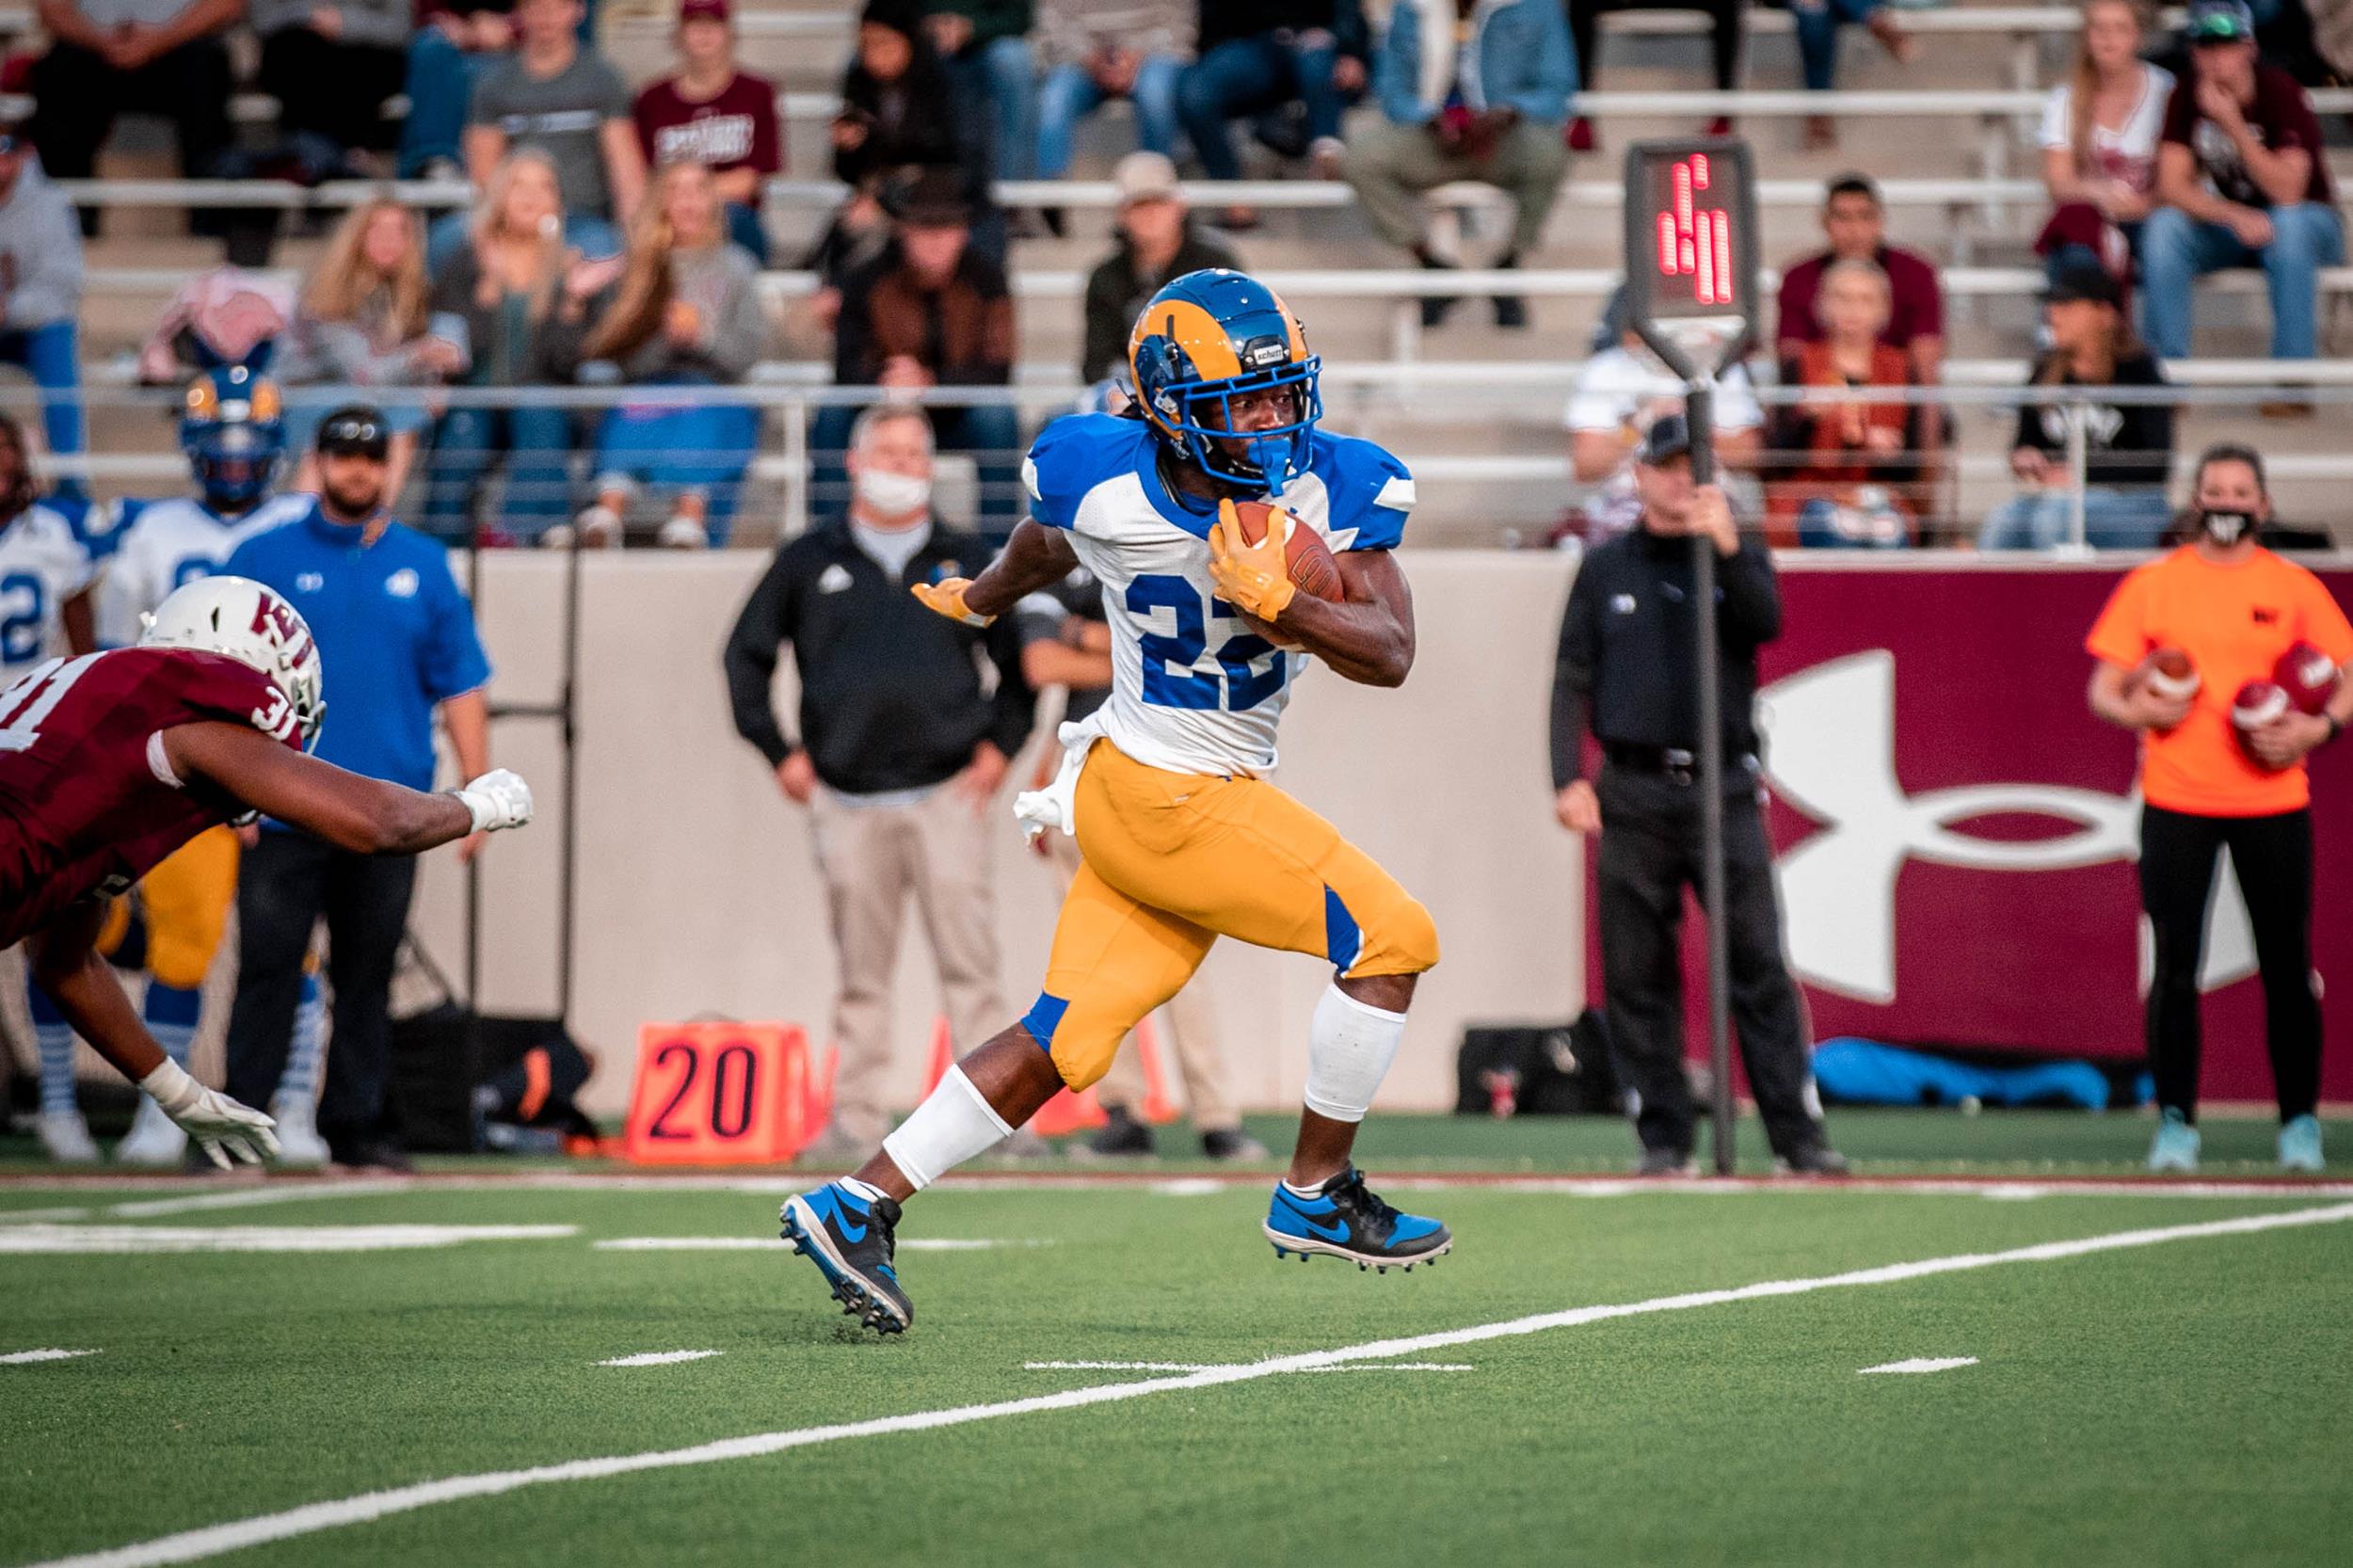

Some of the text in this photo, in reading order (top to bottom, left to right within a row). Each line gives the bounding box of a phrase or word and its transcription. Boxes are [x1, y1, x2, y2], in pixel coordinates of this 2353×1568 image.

[1125, 573, 1287, 712] 22
[251, 686, 298, 743] 31
[649, 1045, 757, 1139] 20
